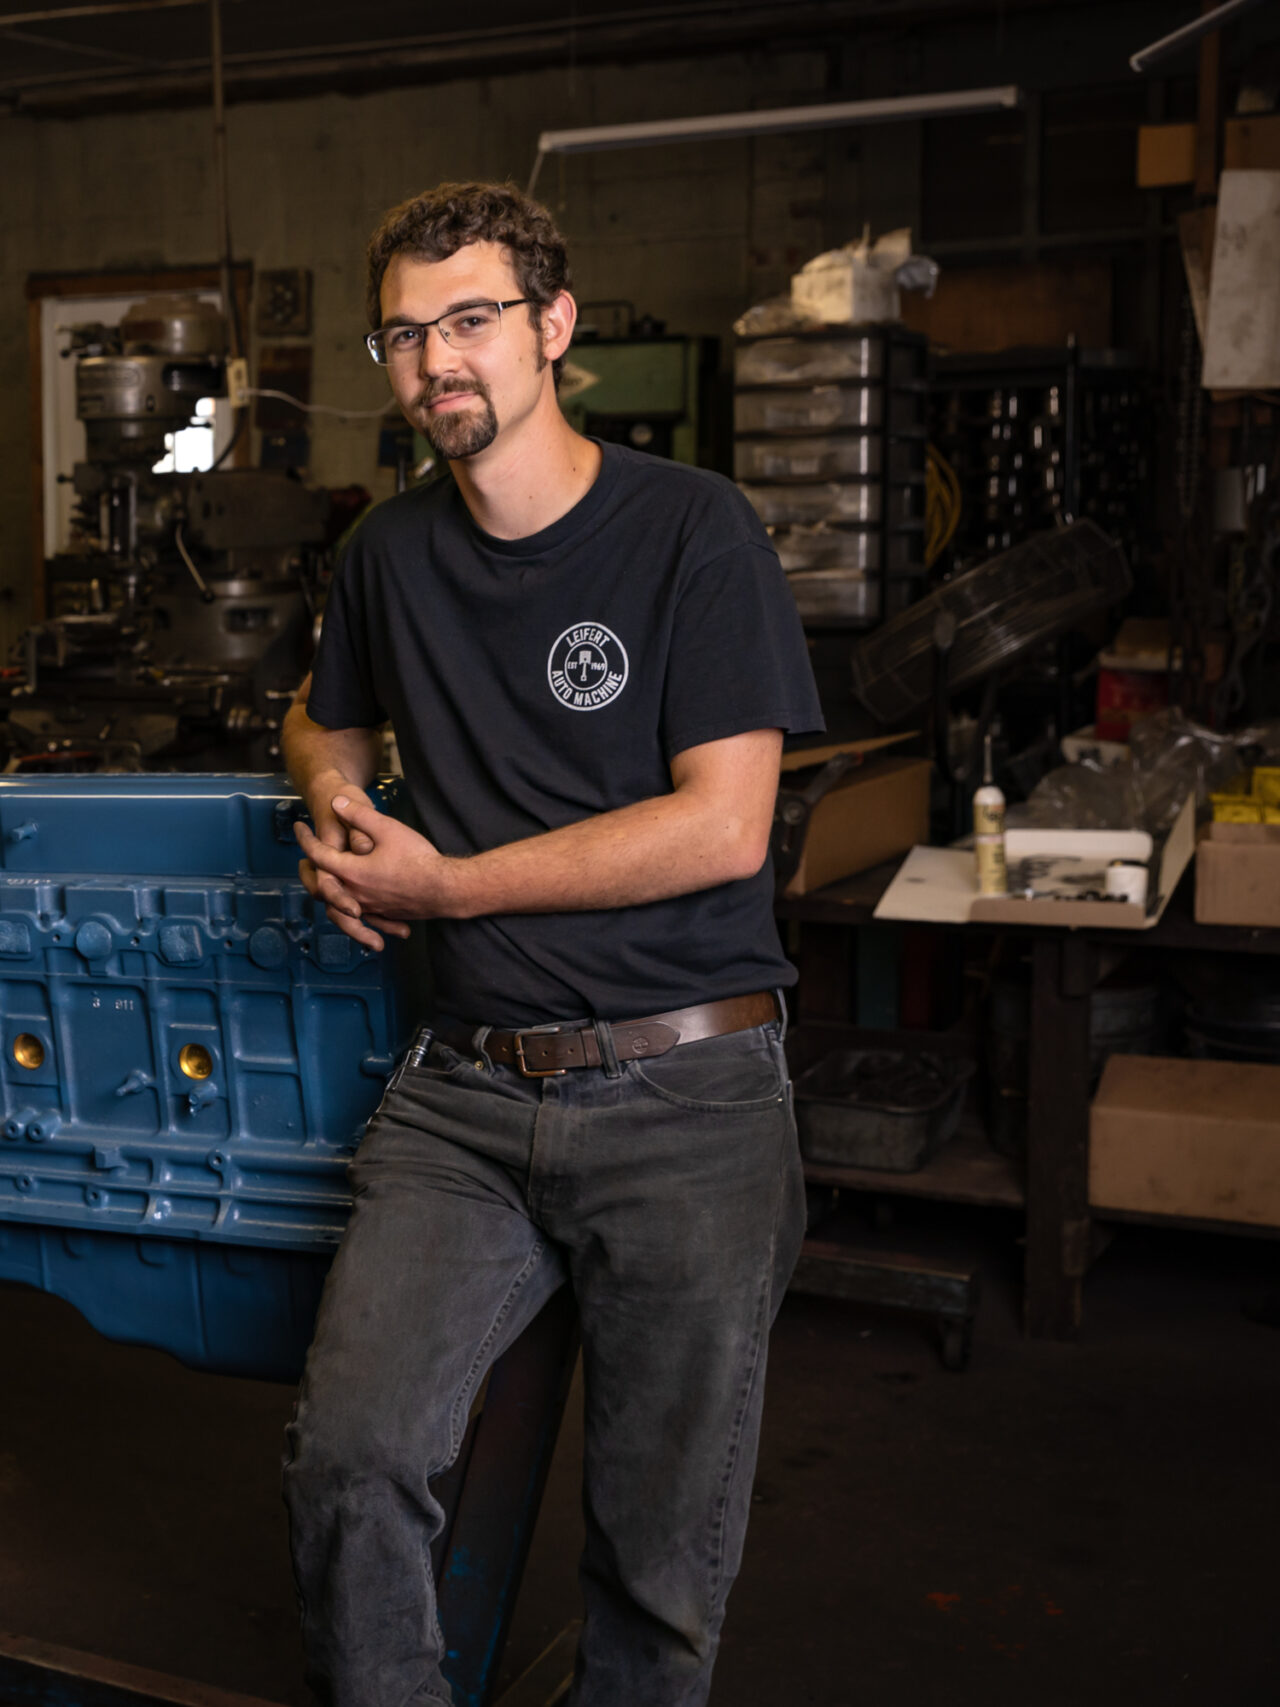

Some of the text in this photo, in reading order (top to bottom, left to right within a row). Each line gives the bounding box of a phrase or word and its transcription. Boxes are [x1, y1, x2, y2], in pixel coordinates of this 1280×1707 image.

[566, 628, 610, 647] LEIFERT
[567, 661, 605, 671] EST 1969
[552, 670, 623, 706] AUTO MACHINE
